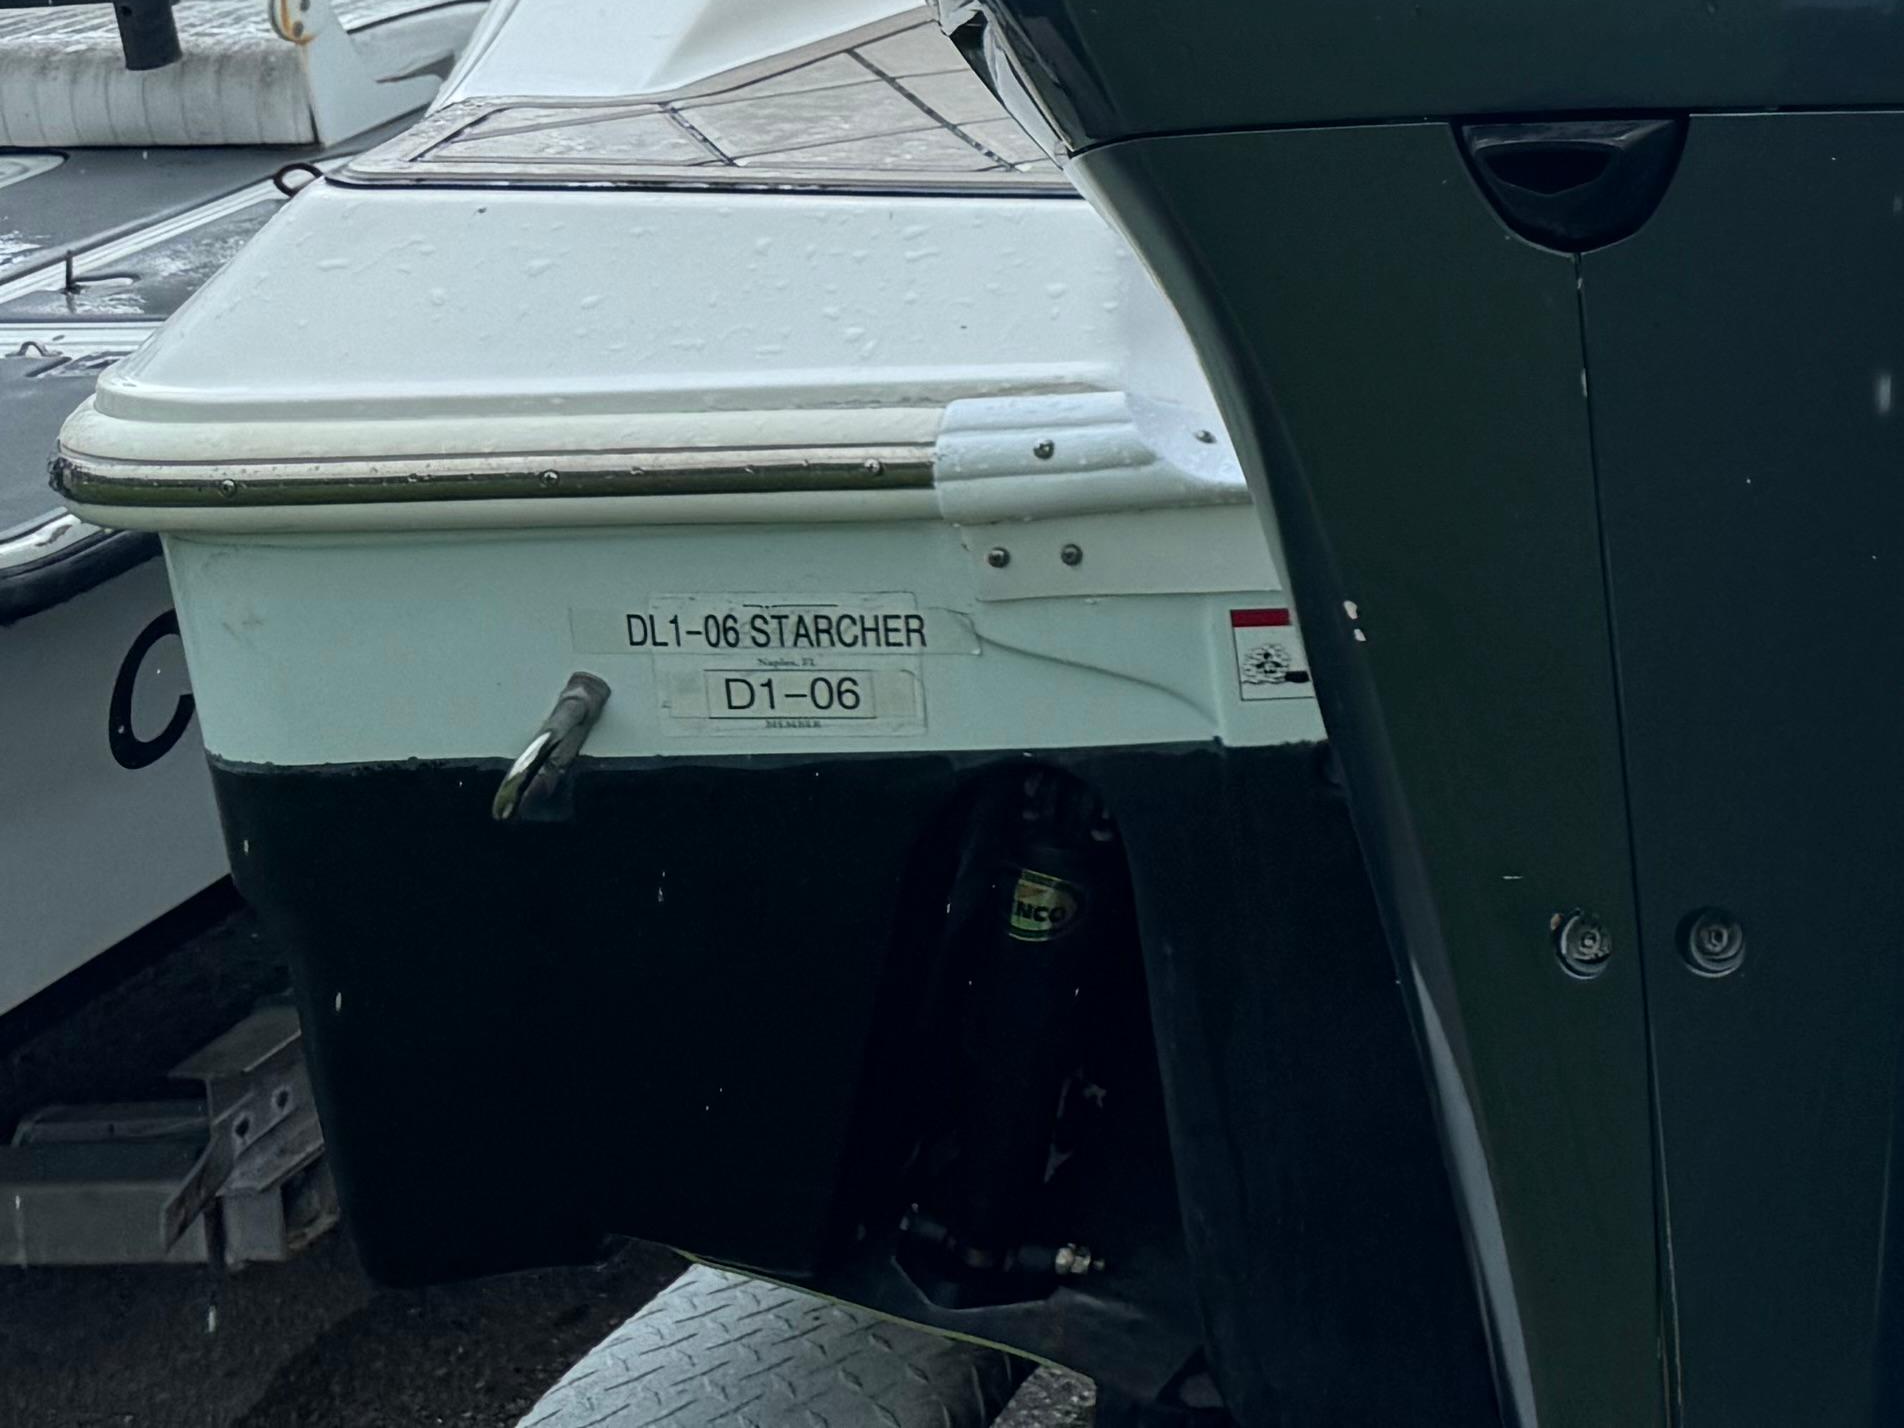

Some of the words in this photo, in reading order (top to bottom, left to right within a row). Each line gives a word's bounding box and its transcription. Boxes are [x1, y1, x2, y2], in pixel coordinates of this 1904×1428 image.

[625, 613, 741, 649] DL1-06
[748, 612, 929, 650] STARCHER
[724, 675, 862, 712] D1-06
